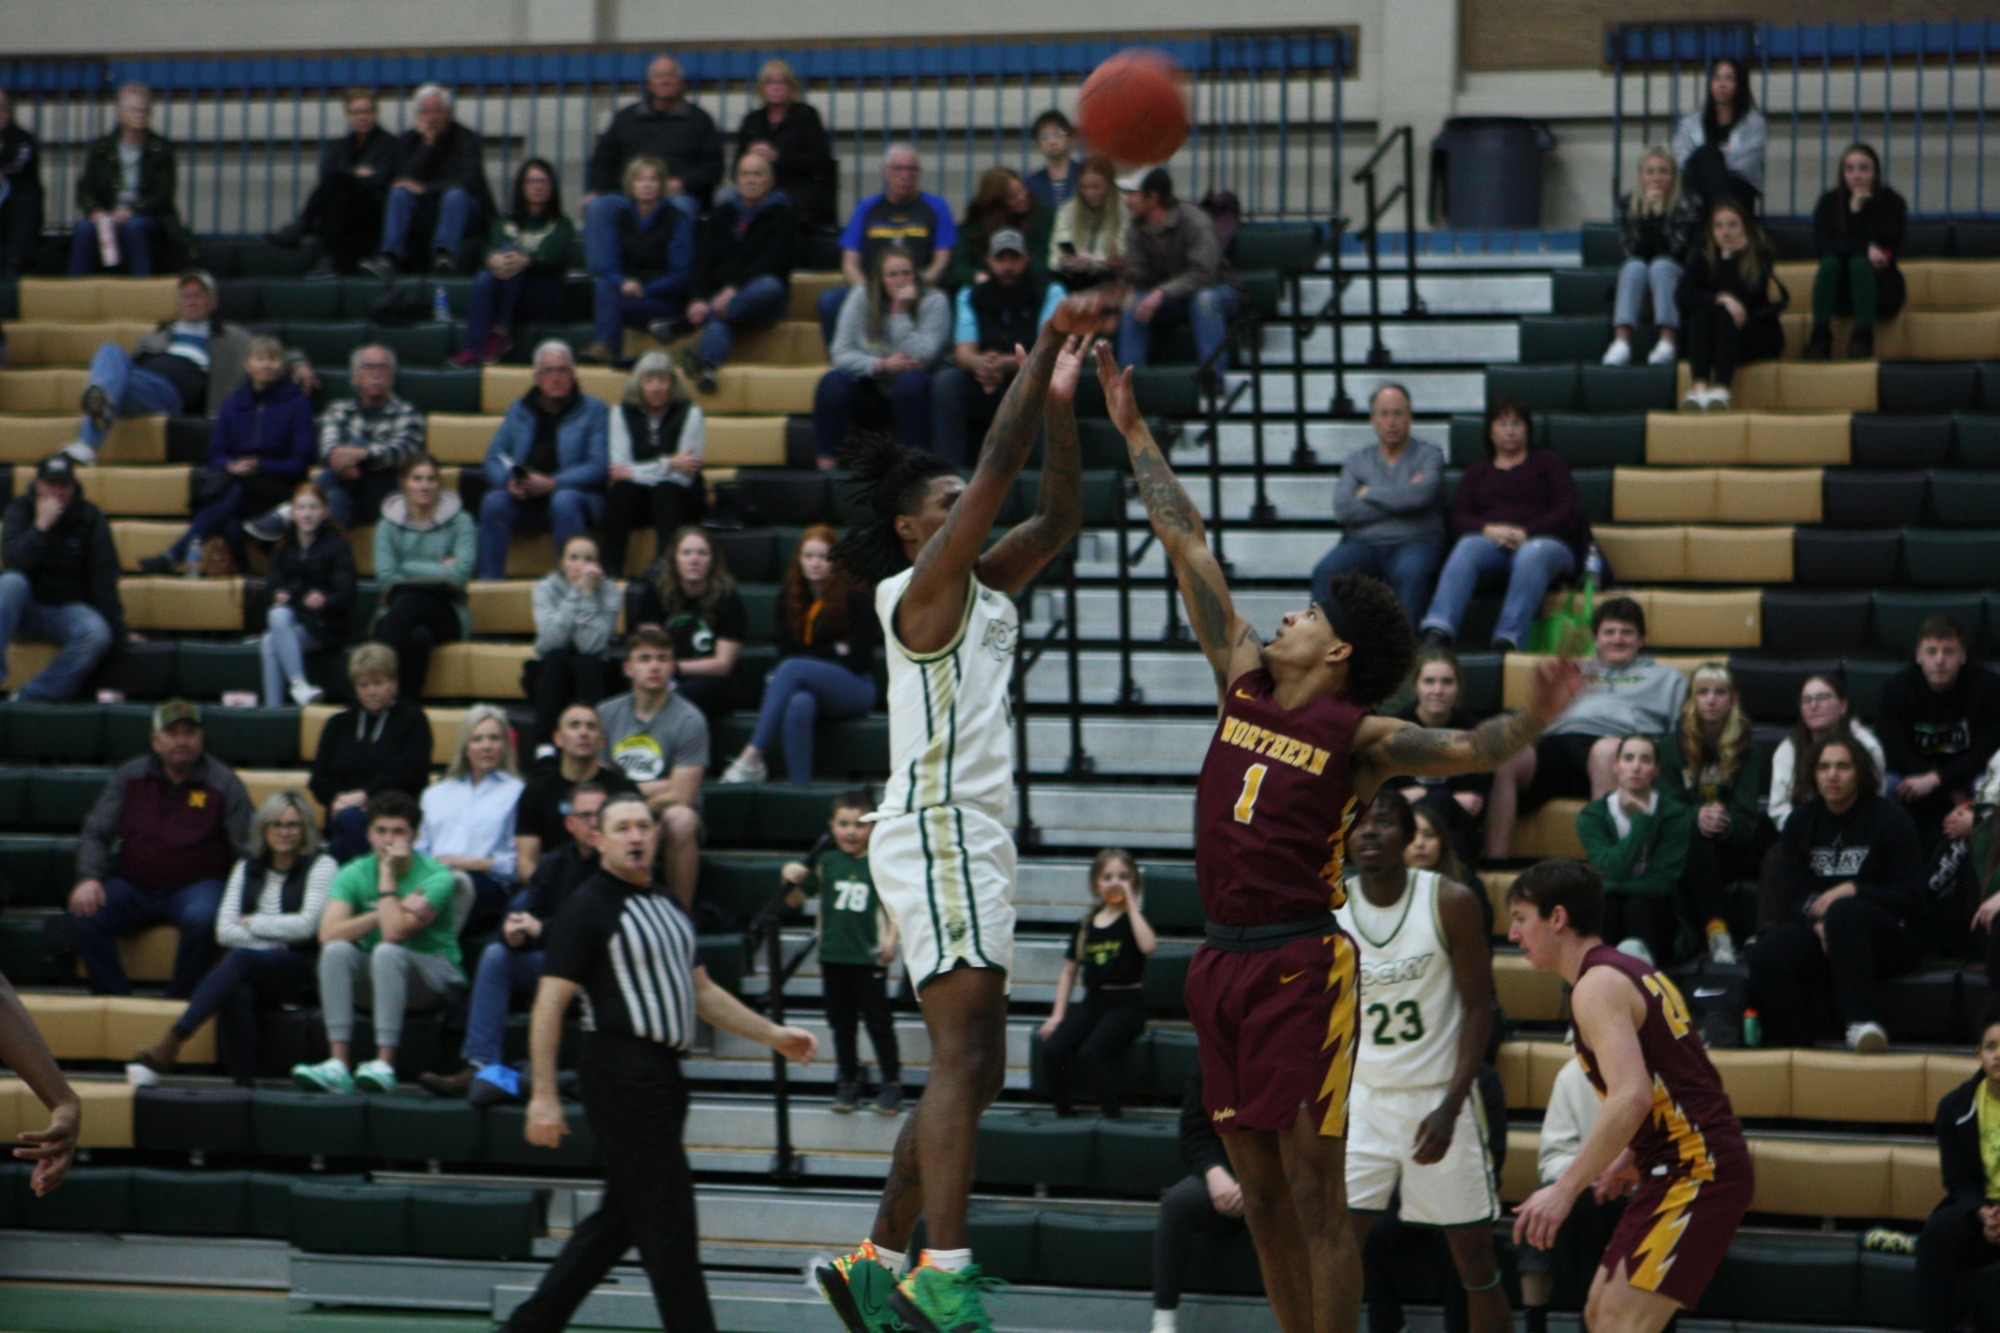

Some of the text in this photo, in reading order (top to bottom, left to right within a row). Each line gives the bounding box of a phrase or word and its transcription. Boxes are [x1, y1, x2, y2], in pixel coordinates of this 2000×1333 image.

[1221, 715, 1331, 776] NORTHERN
[1234, 763, 1268, 824] 1
[834, 881, 869, 912] 78
[1367, 1000, 1424, 1045] 23
